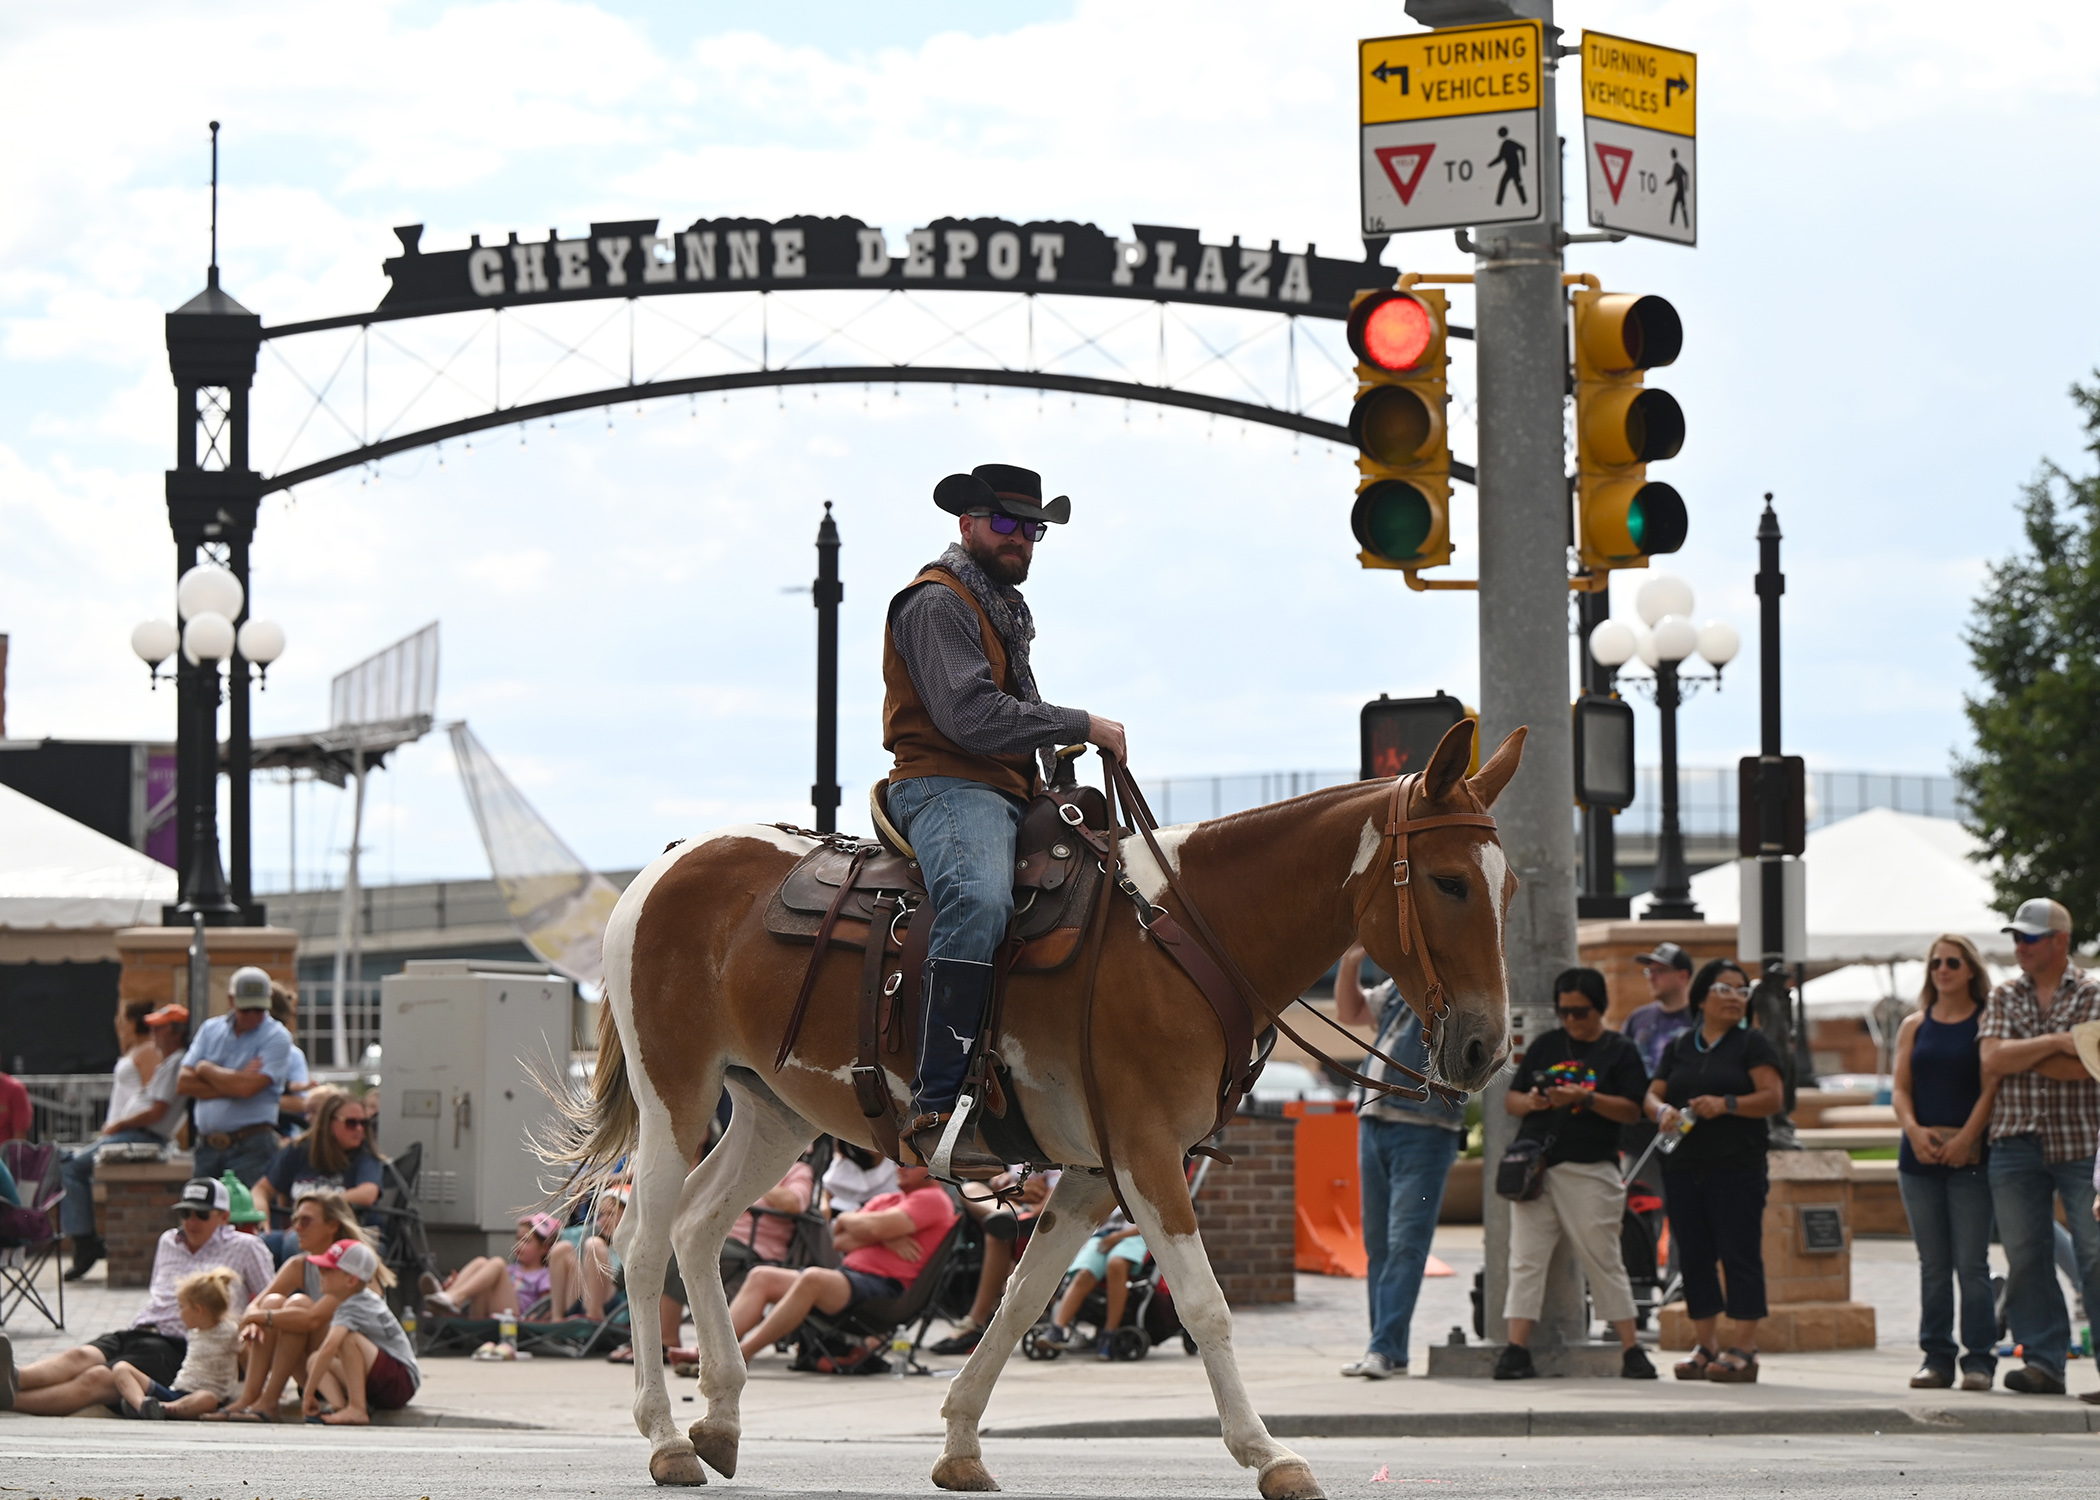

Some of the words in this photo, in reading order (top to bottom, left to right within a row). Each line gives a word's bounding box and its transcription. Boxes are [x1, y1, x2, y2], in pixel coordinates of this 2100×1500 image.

[1423, 36, 1527, 67] TURNING
[1590, 44, 1657, 79] TURNING
[1420, 71, 1531, 103] VEHICLES
[1588, 80, 1659, 114] VEHICLES
[1444, 159, 1474, 183] TO
[1638, 169, 1658, 194] TO
[1369, 215, 1386, 232] 16
[468, 228, 807, 297] CHEYENNE
[856, 228, 1065, 282] DEPOT
[1111, 239, 1313, 303] PLAZA
